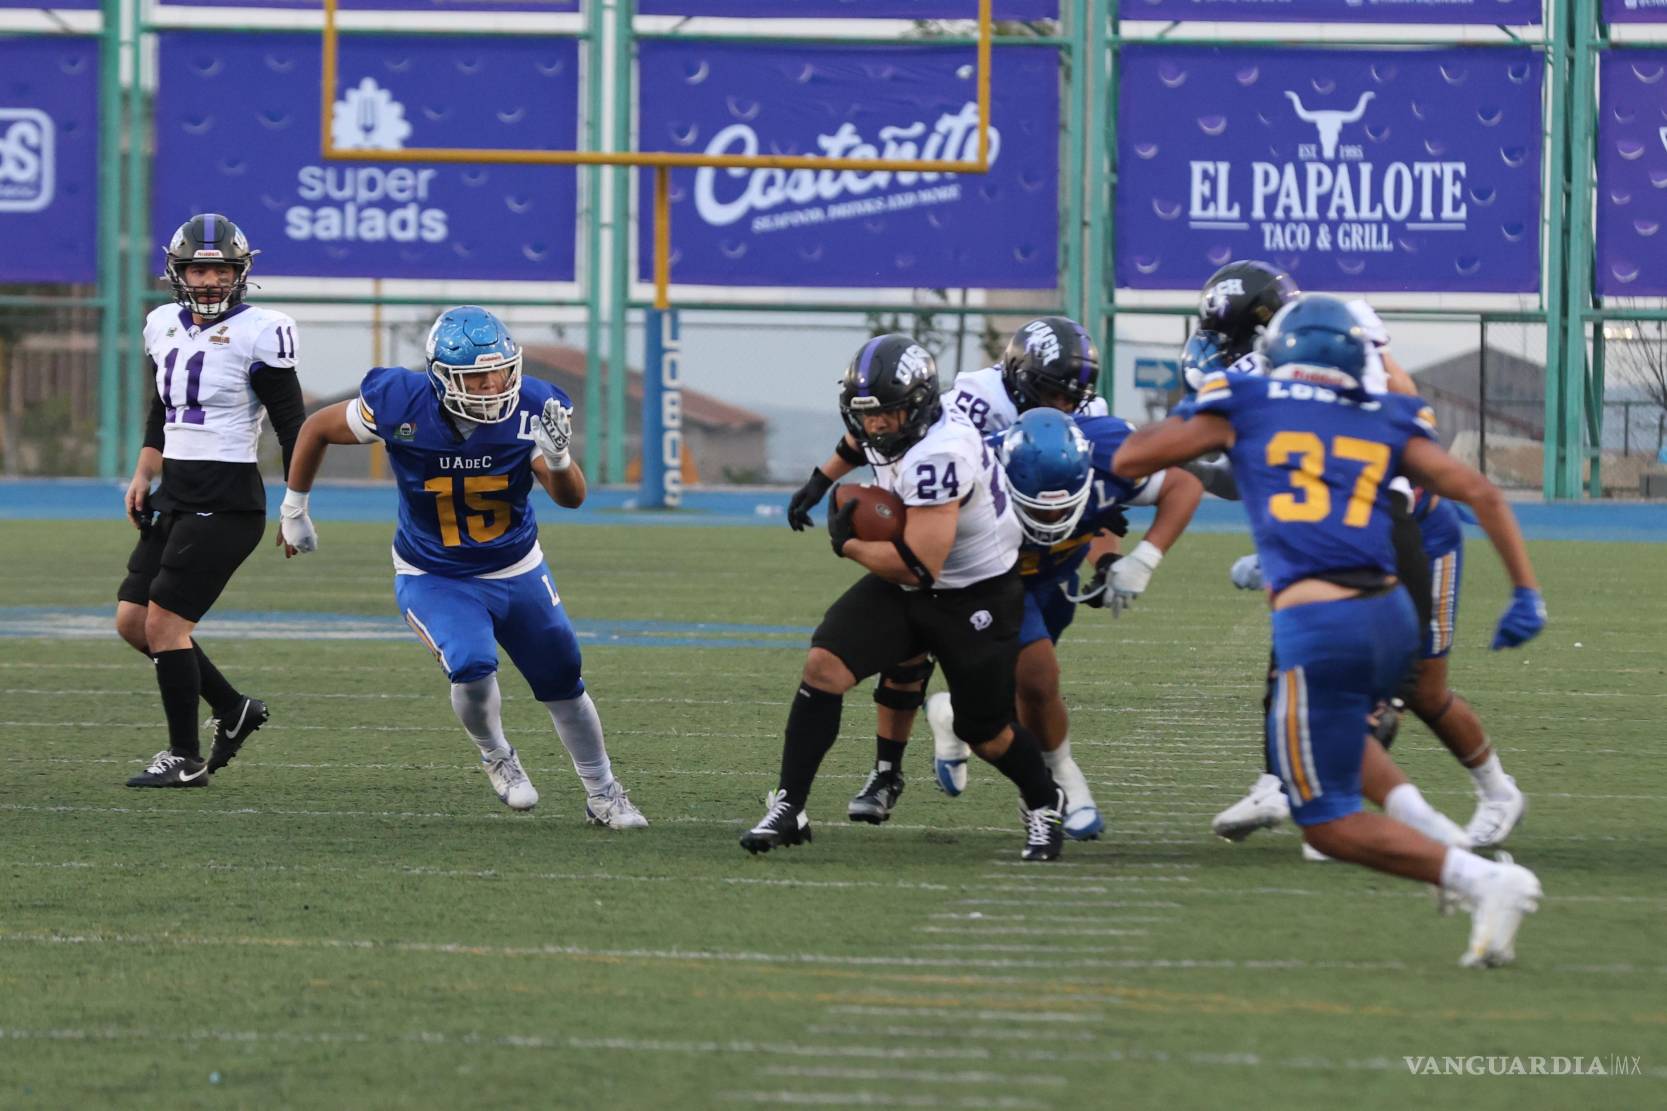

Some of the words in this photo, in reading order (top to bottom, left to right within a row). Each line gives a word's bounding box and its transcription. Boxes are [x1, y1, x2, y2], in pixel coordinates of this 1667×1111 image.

[298, 166, 437, 205] super
[1190, 161, 1240, 220] EL
[1252, 161, 1467, 221] PAPALOTE
[286, 201, 448, 241] salads
[1262, 223, 1310, 250] TACO
[1316, 223, 1331, 250] &
[1337, 223, 1393, 251] GRILL
[275, 326, 295, 359] 11
[163, 347, 206, 425] 11
[661, 311, 683, 507] LOBOS
[954, 390, 991, 429] 58
[915, 462, 960, 500] 24
[1265, 431, 1391, 528] 37
[424, 474, 511, 547] 15
